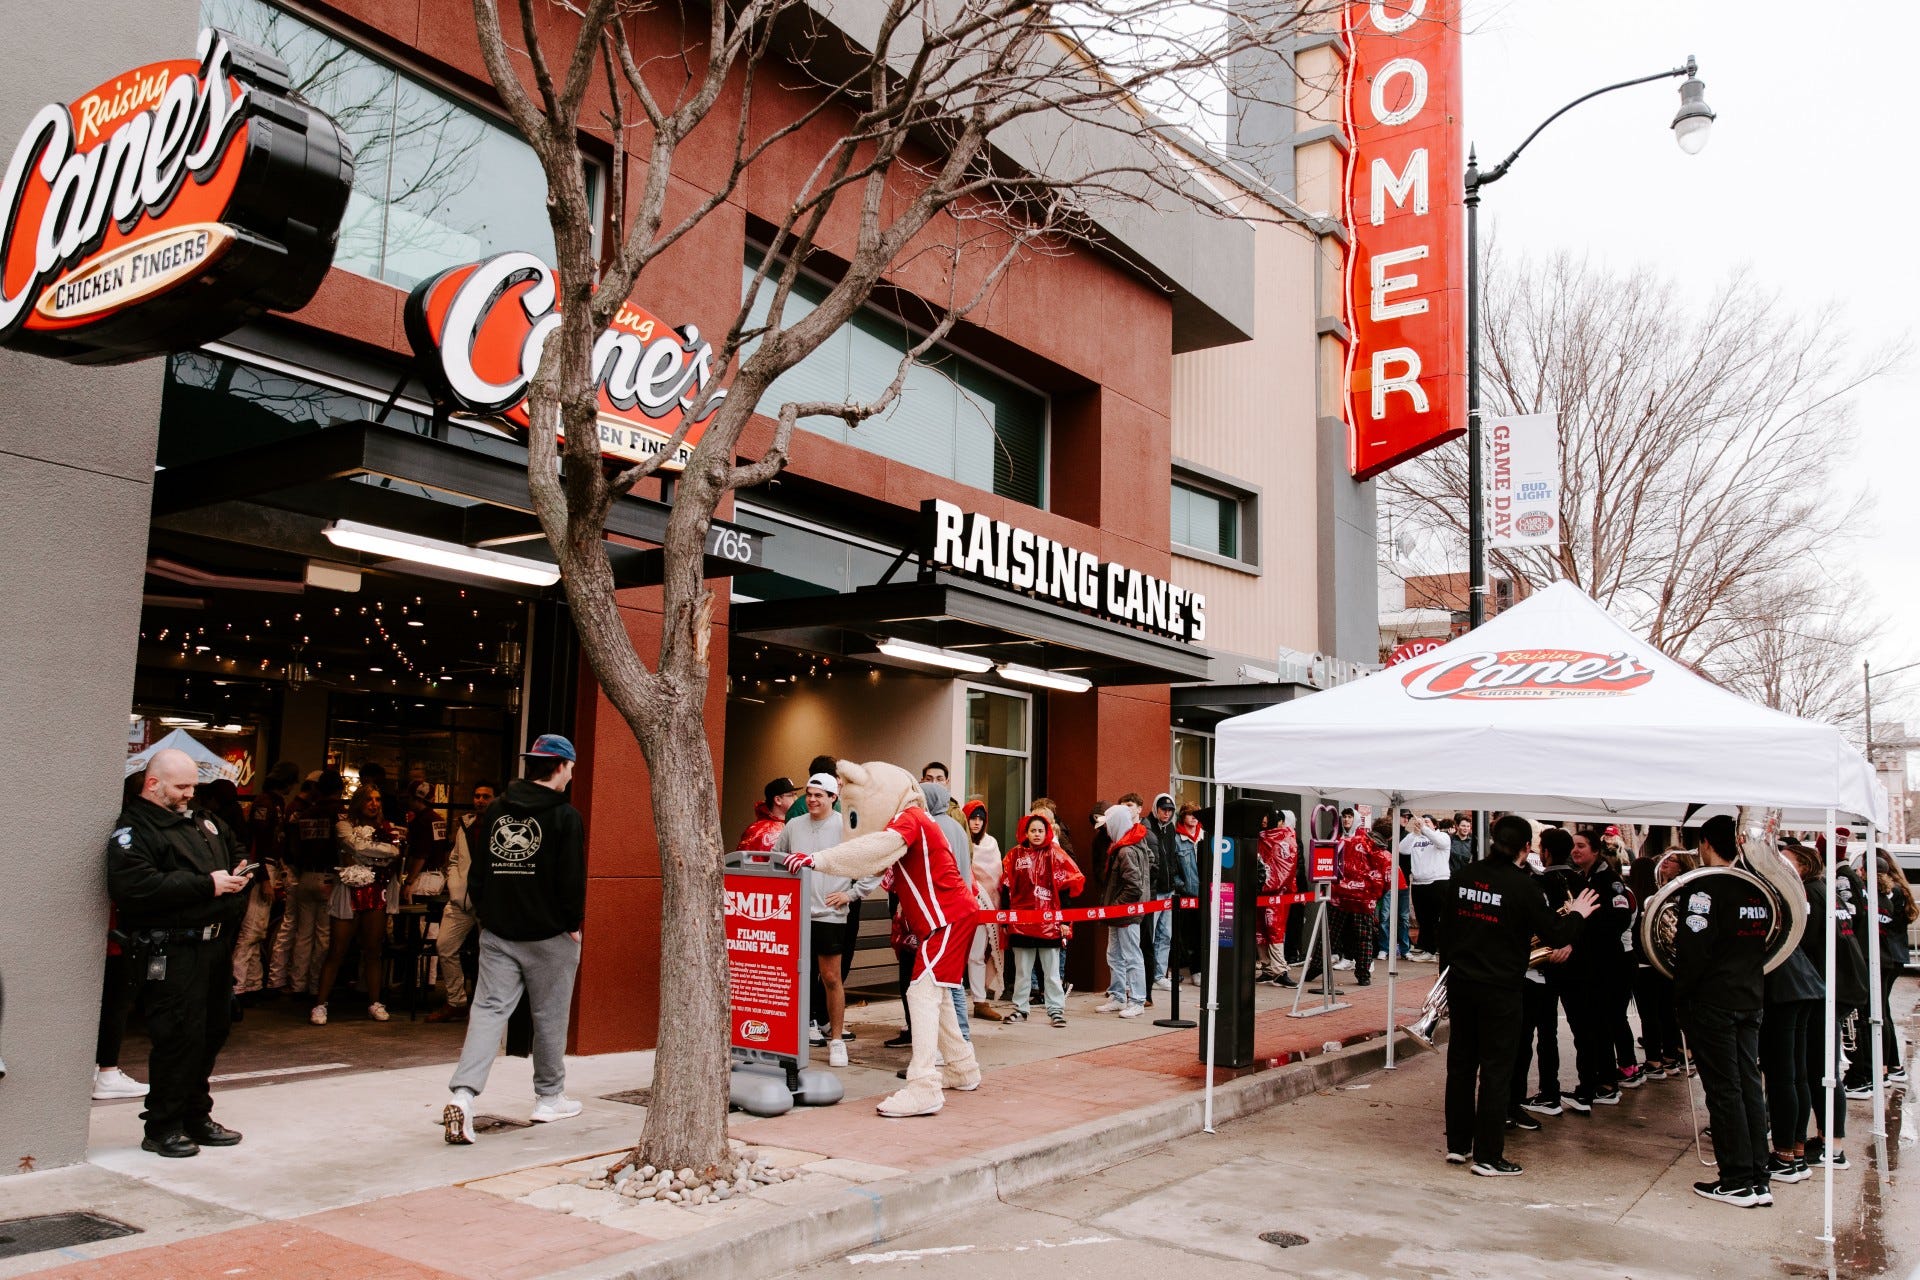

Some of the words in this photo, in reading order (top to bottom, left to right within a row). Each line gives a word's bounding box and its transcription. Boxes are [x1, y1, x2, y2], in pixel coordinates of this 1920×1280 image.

[78, 68, 169, 145] Raising
[0, 27, 249, 331] Cane's
[56, 274, 124, 310] CHICKEN
[130, 231, 208, 283] FINGERS
[630, 431, 697, 466] FINR
[1494, 426, 1510, 490] GAME
[1516, 490, 1552, 501] LIGHT
[1521, 482, 1547, 492] BUD
[1495, 496, 1511, 539] DAY
[711, 526, 752, 563] 765
[934, 498, 1099, 610] RAISING
[1107, 562, 1206, 641] CANE'S
[1391, 643, 1438, 666] HIPO
[1502, 650, 1583, 663] Raising
[1405, 650, 1656, 700] Cane's
[490, 836, 540, 859] OUTFITTERS
[1458, 886, 1502, 907] PRIDE
[1474, 880, 1489, 890] THE
[724, 891, 792, 920] SMILE
[1739, 906, 1768, 919] PRID
[727, 939, 758, 952] TAKING
[760, 942, 789, 956] PLACE
[737, 928, 776, 942] FILMING
